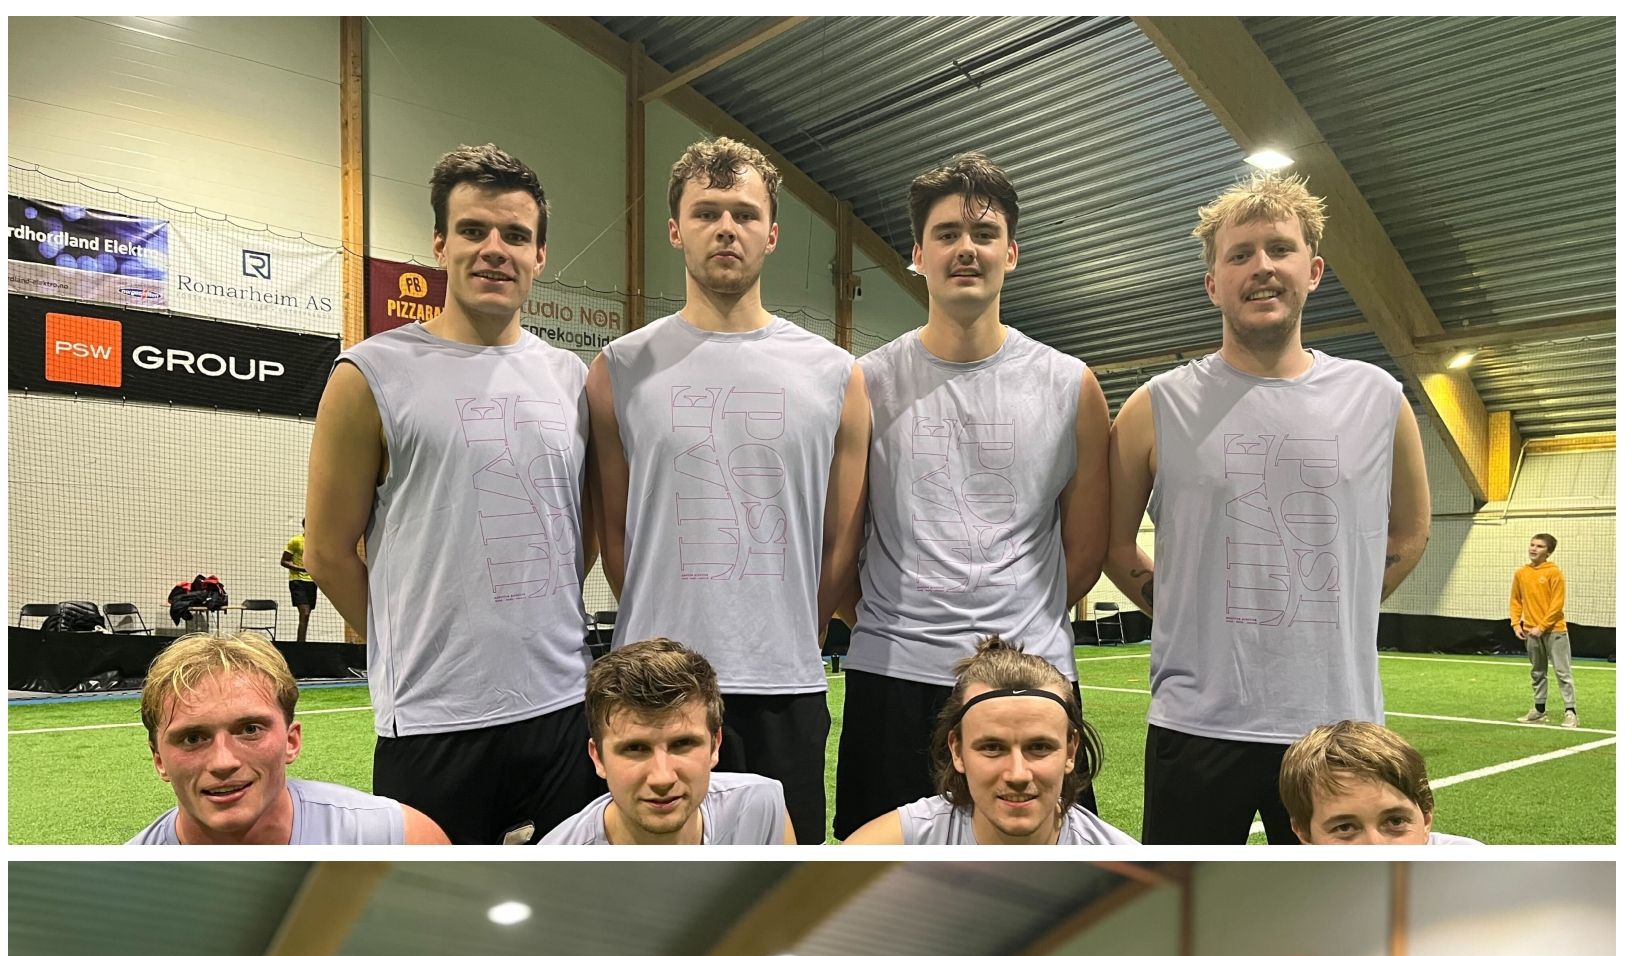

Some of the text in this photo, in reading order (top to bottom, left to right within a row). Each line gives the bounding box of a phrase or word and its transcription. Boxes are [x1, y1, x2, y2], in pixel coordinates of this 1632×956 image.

[177, 275, 299, 307] Romarheim
[306, 295, 332, 312] AS
[405, 277, 422, 293] PB
[387, 299, 443, 321] PIZZABA
[55, 341, 285, 382] PSW GROUP
